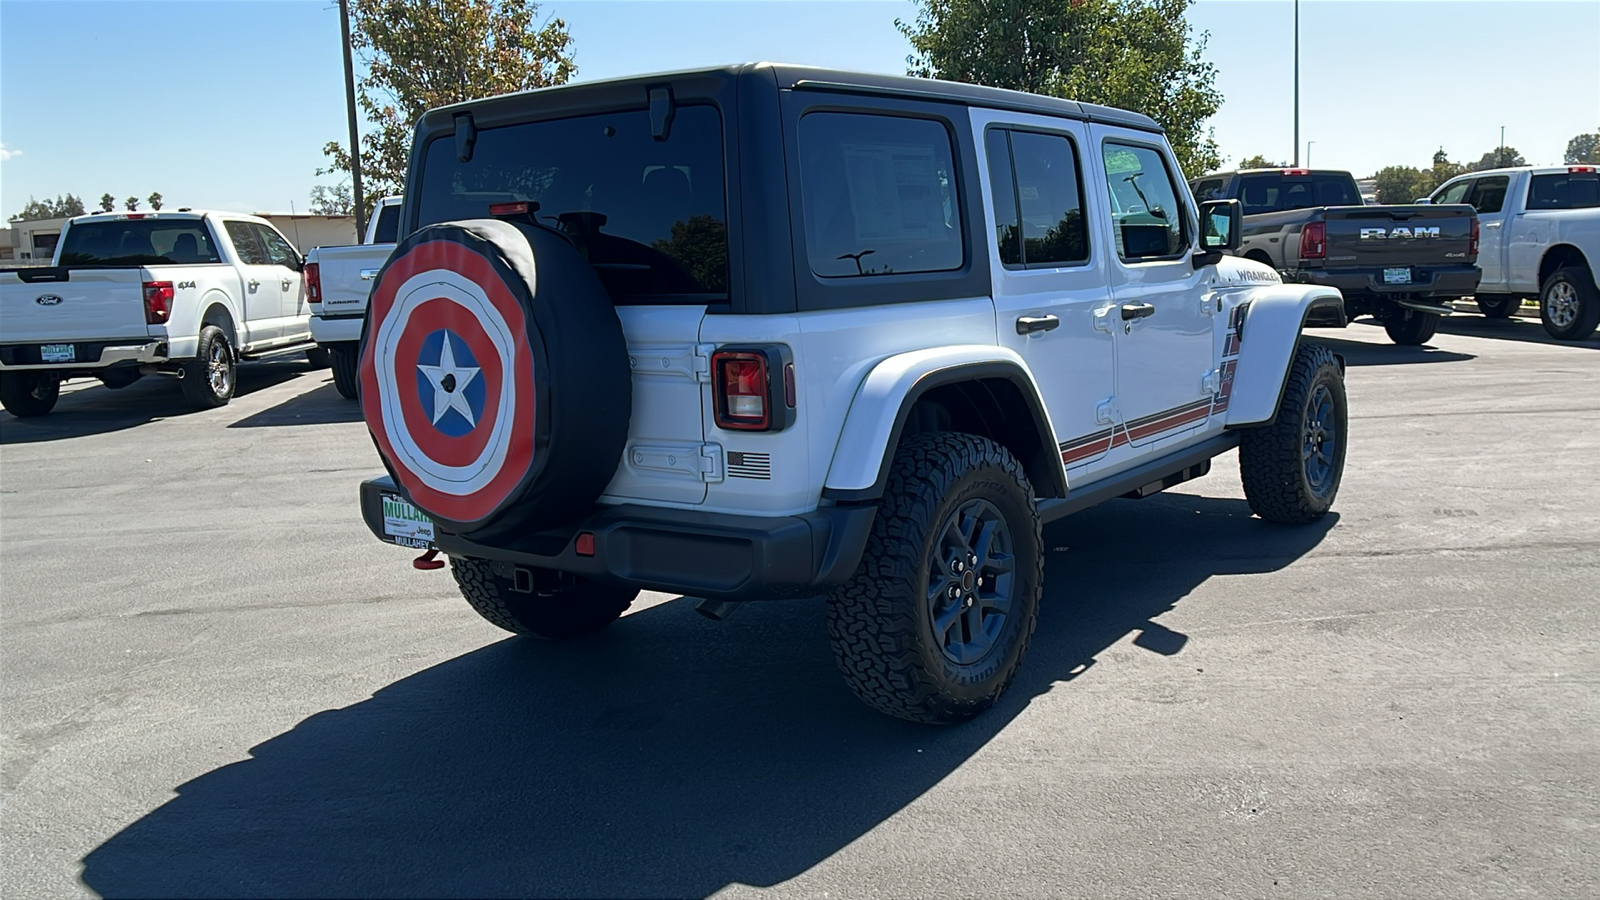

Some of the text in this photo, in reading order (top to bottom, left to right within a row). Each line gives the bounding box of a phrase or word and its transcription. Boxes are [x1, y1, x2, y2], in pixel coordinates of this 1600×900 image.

[1360, 227, 1440, 239] RAM
[1236, 269, 1280, 282] WRANGLER
[39, 296, 59, 305] Ford
[416, 526, 431, 537] Jeep
[395, 536, 429, 549] MULLAHEY
